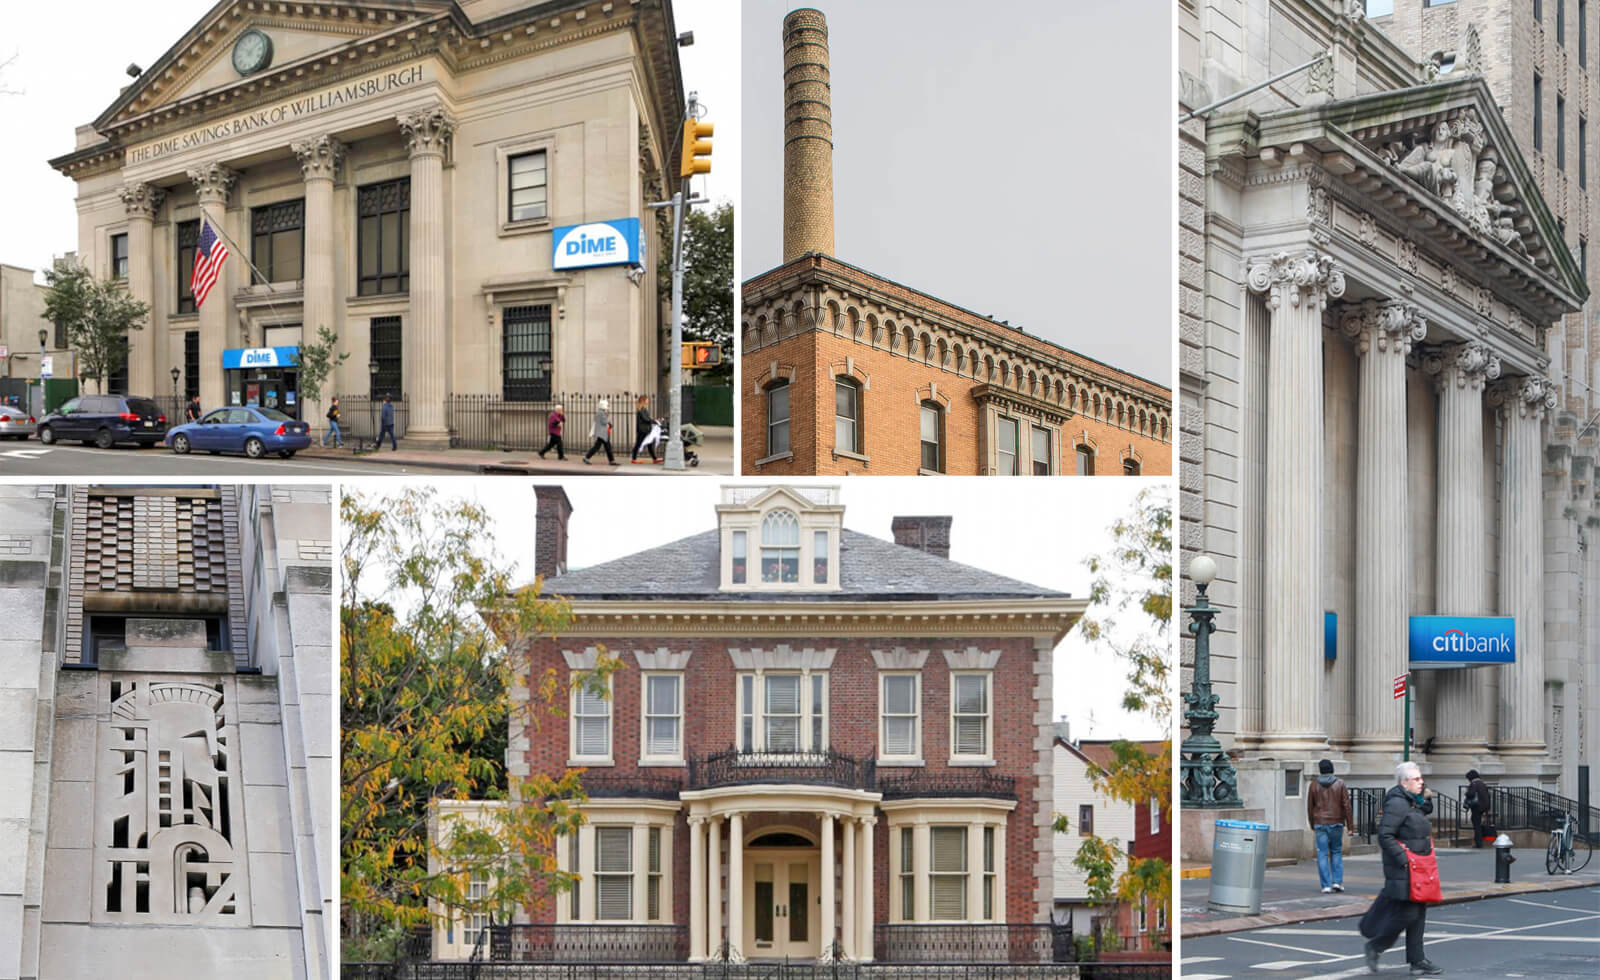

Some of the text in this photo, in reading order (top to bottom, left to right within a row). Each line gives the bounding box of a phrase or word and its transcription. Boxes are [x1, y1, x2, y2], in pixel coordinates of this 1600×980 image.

[131, 65, 423, 162] THE DIME SAVINGS BANK OF WILLIAMSBURGH
[1432, 631, 1510, 653] citibank
